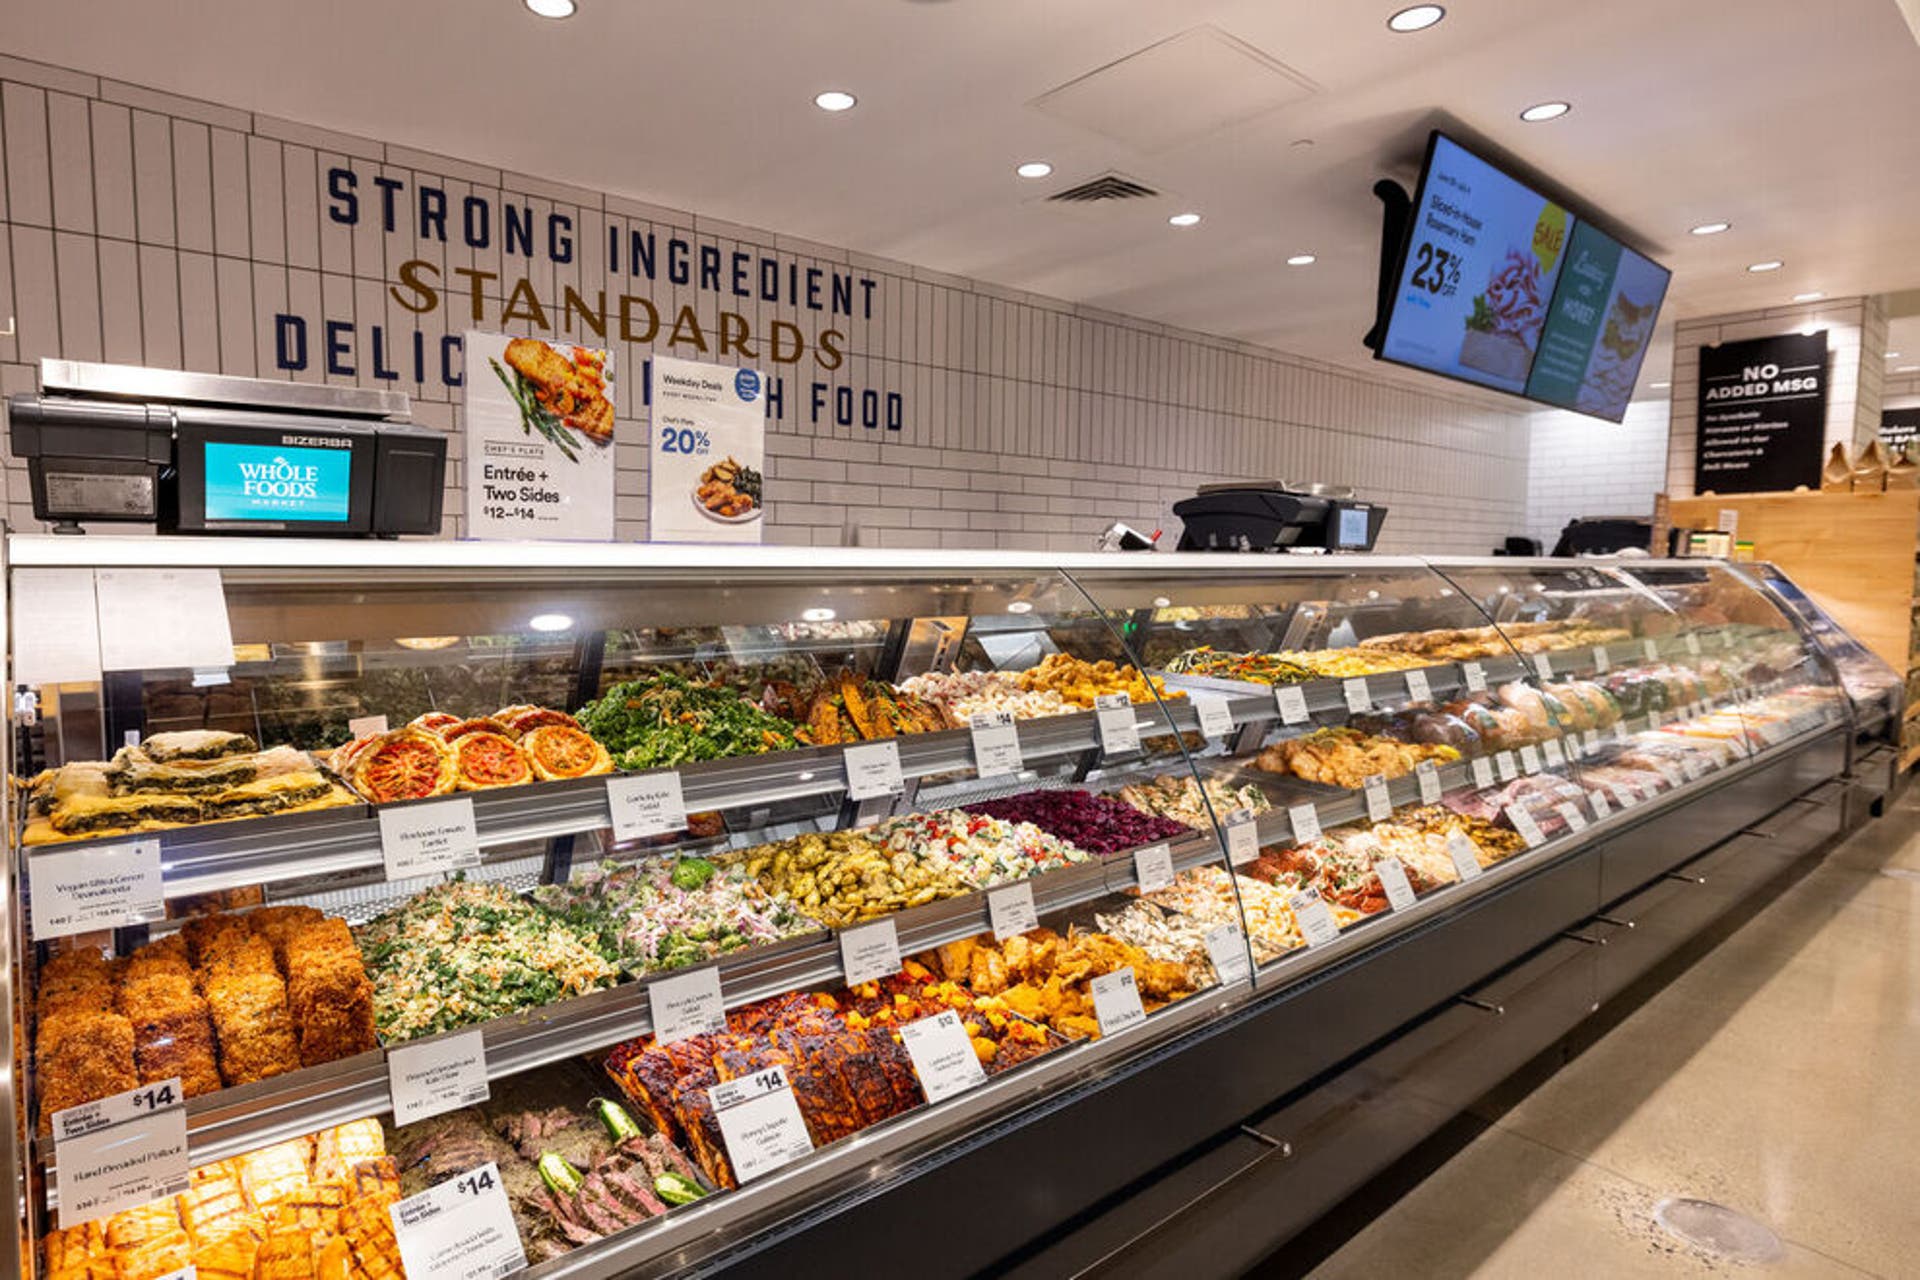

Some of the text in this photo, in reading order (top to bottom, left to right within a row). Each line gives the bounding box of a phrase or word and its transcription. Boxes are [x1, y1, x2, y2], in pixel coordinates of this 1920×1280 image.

[328, 167, 877, 320] STRONG INGREDIENT
[1411, 242, 1463, 294] 23%
[389, 259, 845, 371] STANDARDS
[275, 313, 464, 388] DELIC
[662, 374, 722, 391] Weekday Deals
[1742, 364, 1779, 382] NO
[1706, 377, 1818, 400] ADDED MSG
[812, 381, 903, 432] FOOD
[282, 435, 353, 448] BIZERBA
[661, 427, 710, 454] 20%
[238, 459, 319, 482] WHOLE
[484, 464, 548, 482] Entrée +
[243, 480, 319, 497] FOODS
[483, 484, 560, 503] Two Sides
[251, 499, 306, 508] MARKET
[756, 1071, 782, 1090] $14
[132, 1084, 175, 1110] $14
[457, 1170, 495, 1196] $14
